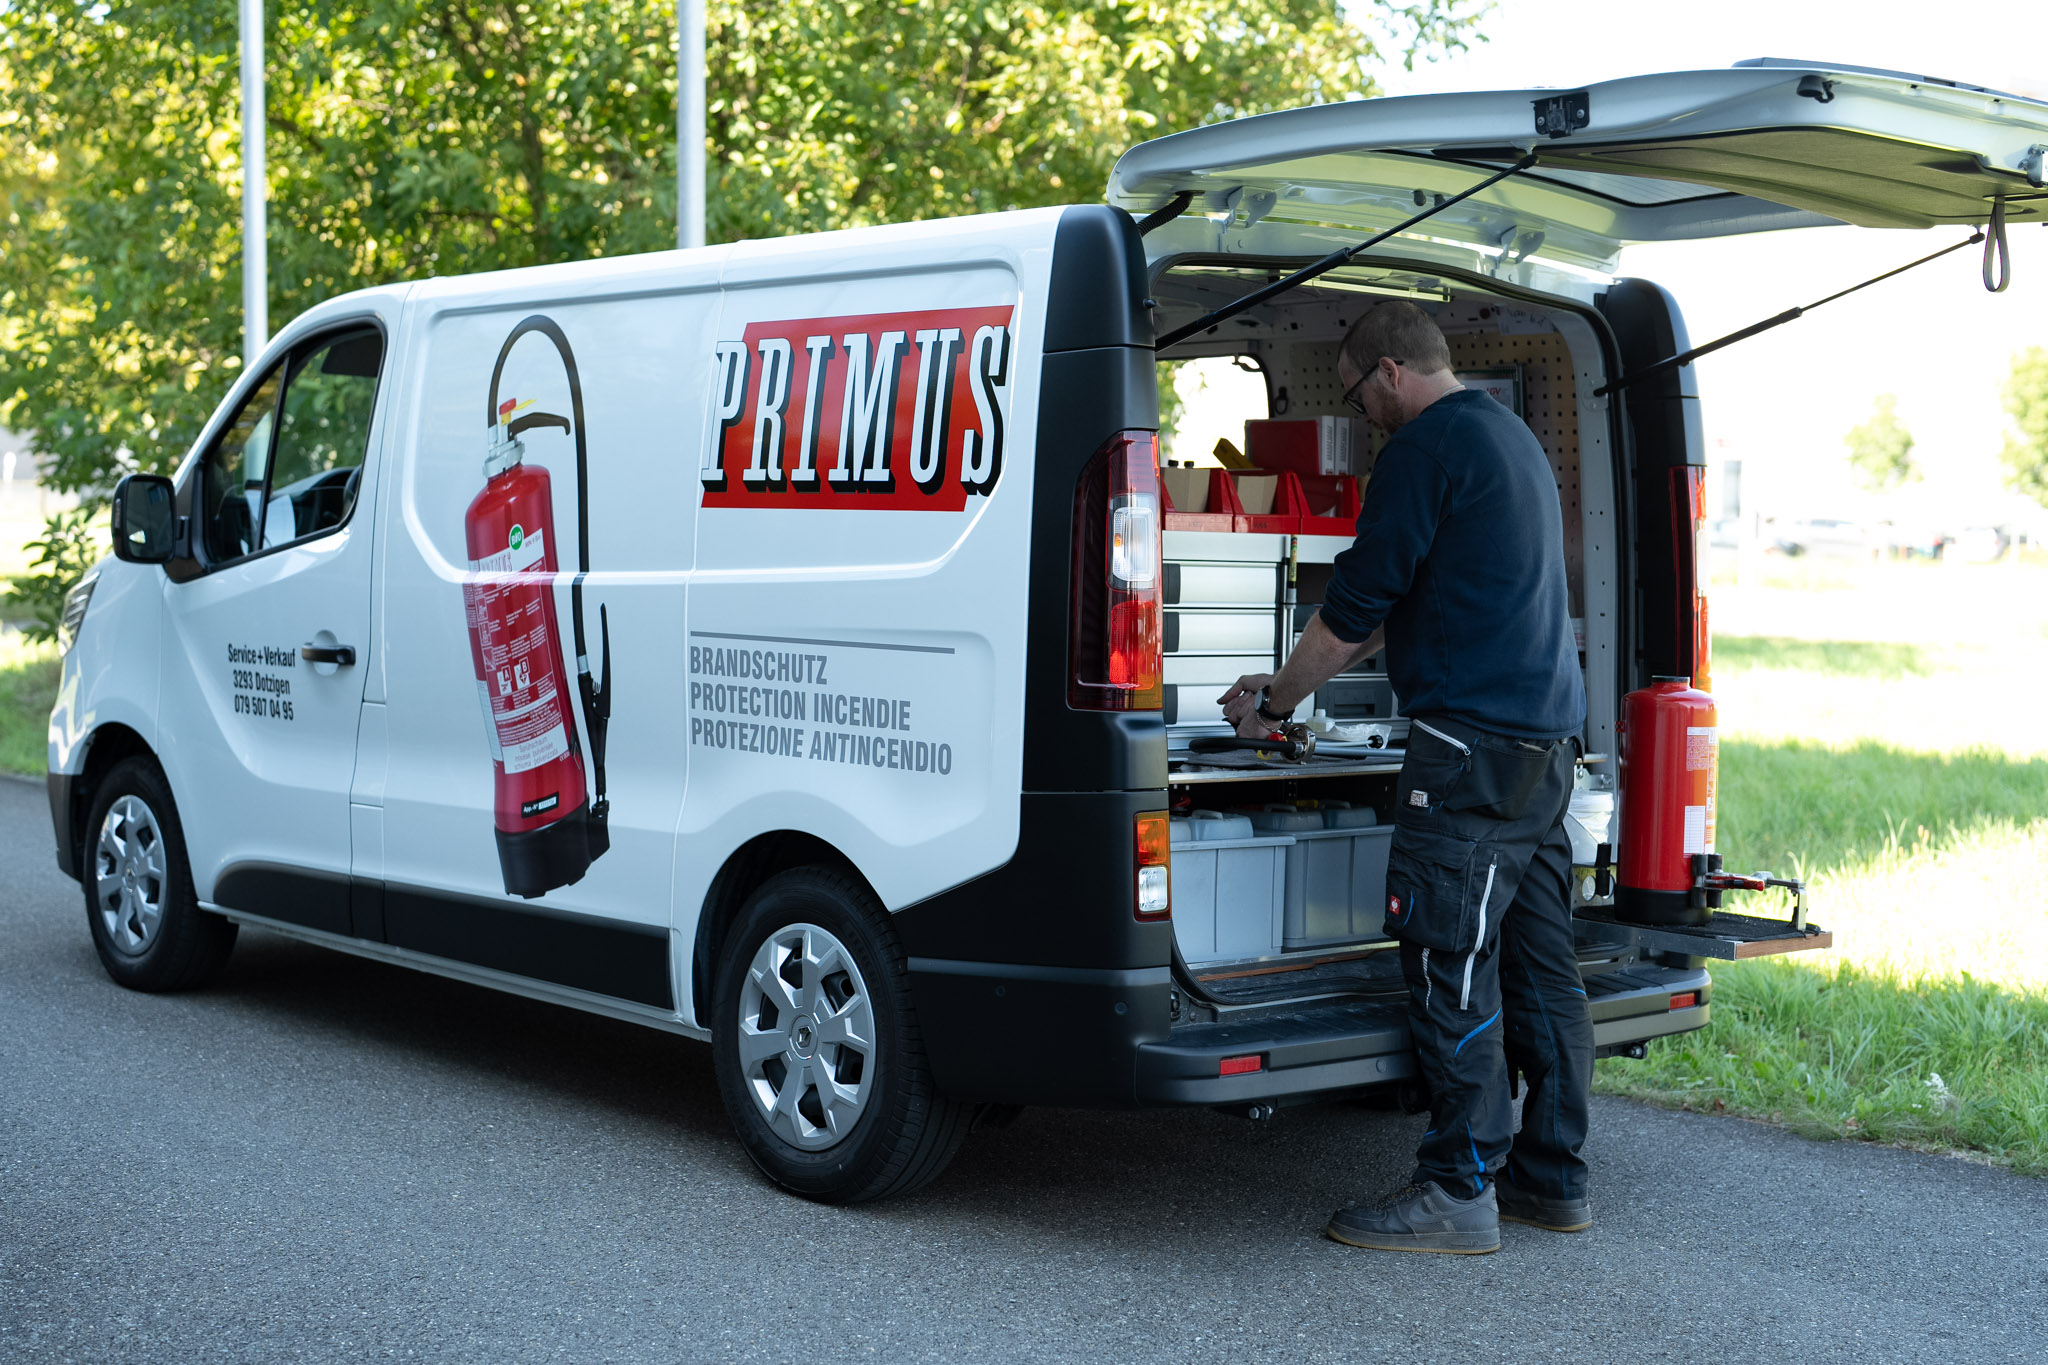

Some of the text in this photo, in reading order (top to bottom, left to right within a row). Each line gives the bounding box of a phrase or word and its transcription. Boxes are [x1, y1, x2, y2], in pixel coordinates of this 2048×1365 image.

[701, 324, 1011, 497] PRIMUS
[233, 669, 291, 698] 3293 Dotzigen
[690, 646, 828, 685] BRANDSCHUTZ
[234, 694, 294, 721] 079 507 04 95
[690, 681, 911, 731] PROTECTION INCENDIE
[691, 717, 953, 776] PROTEZIONE ANTINCENDIO
